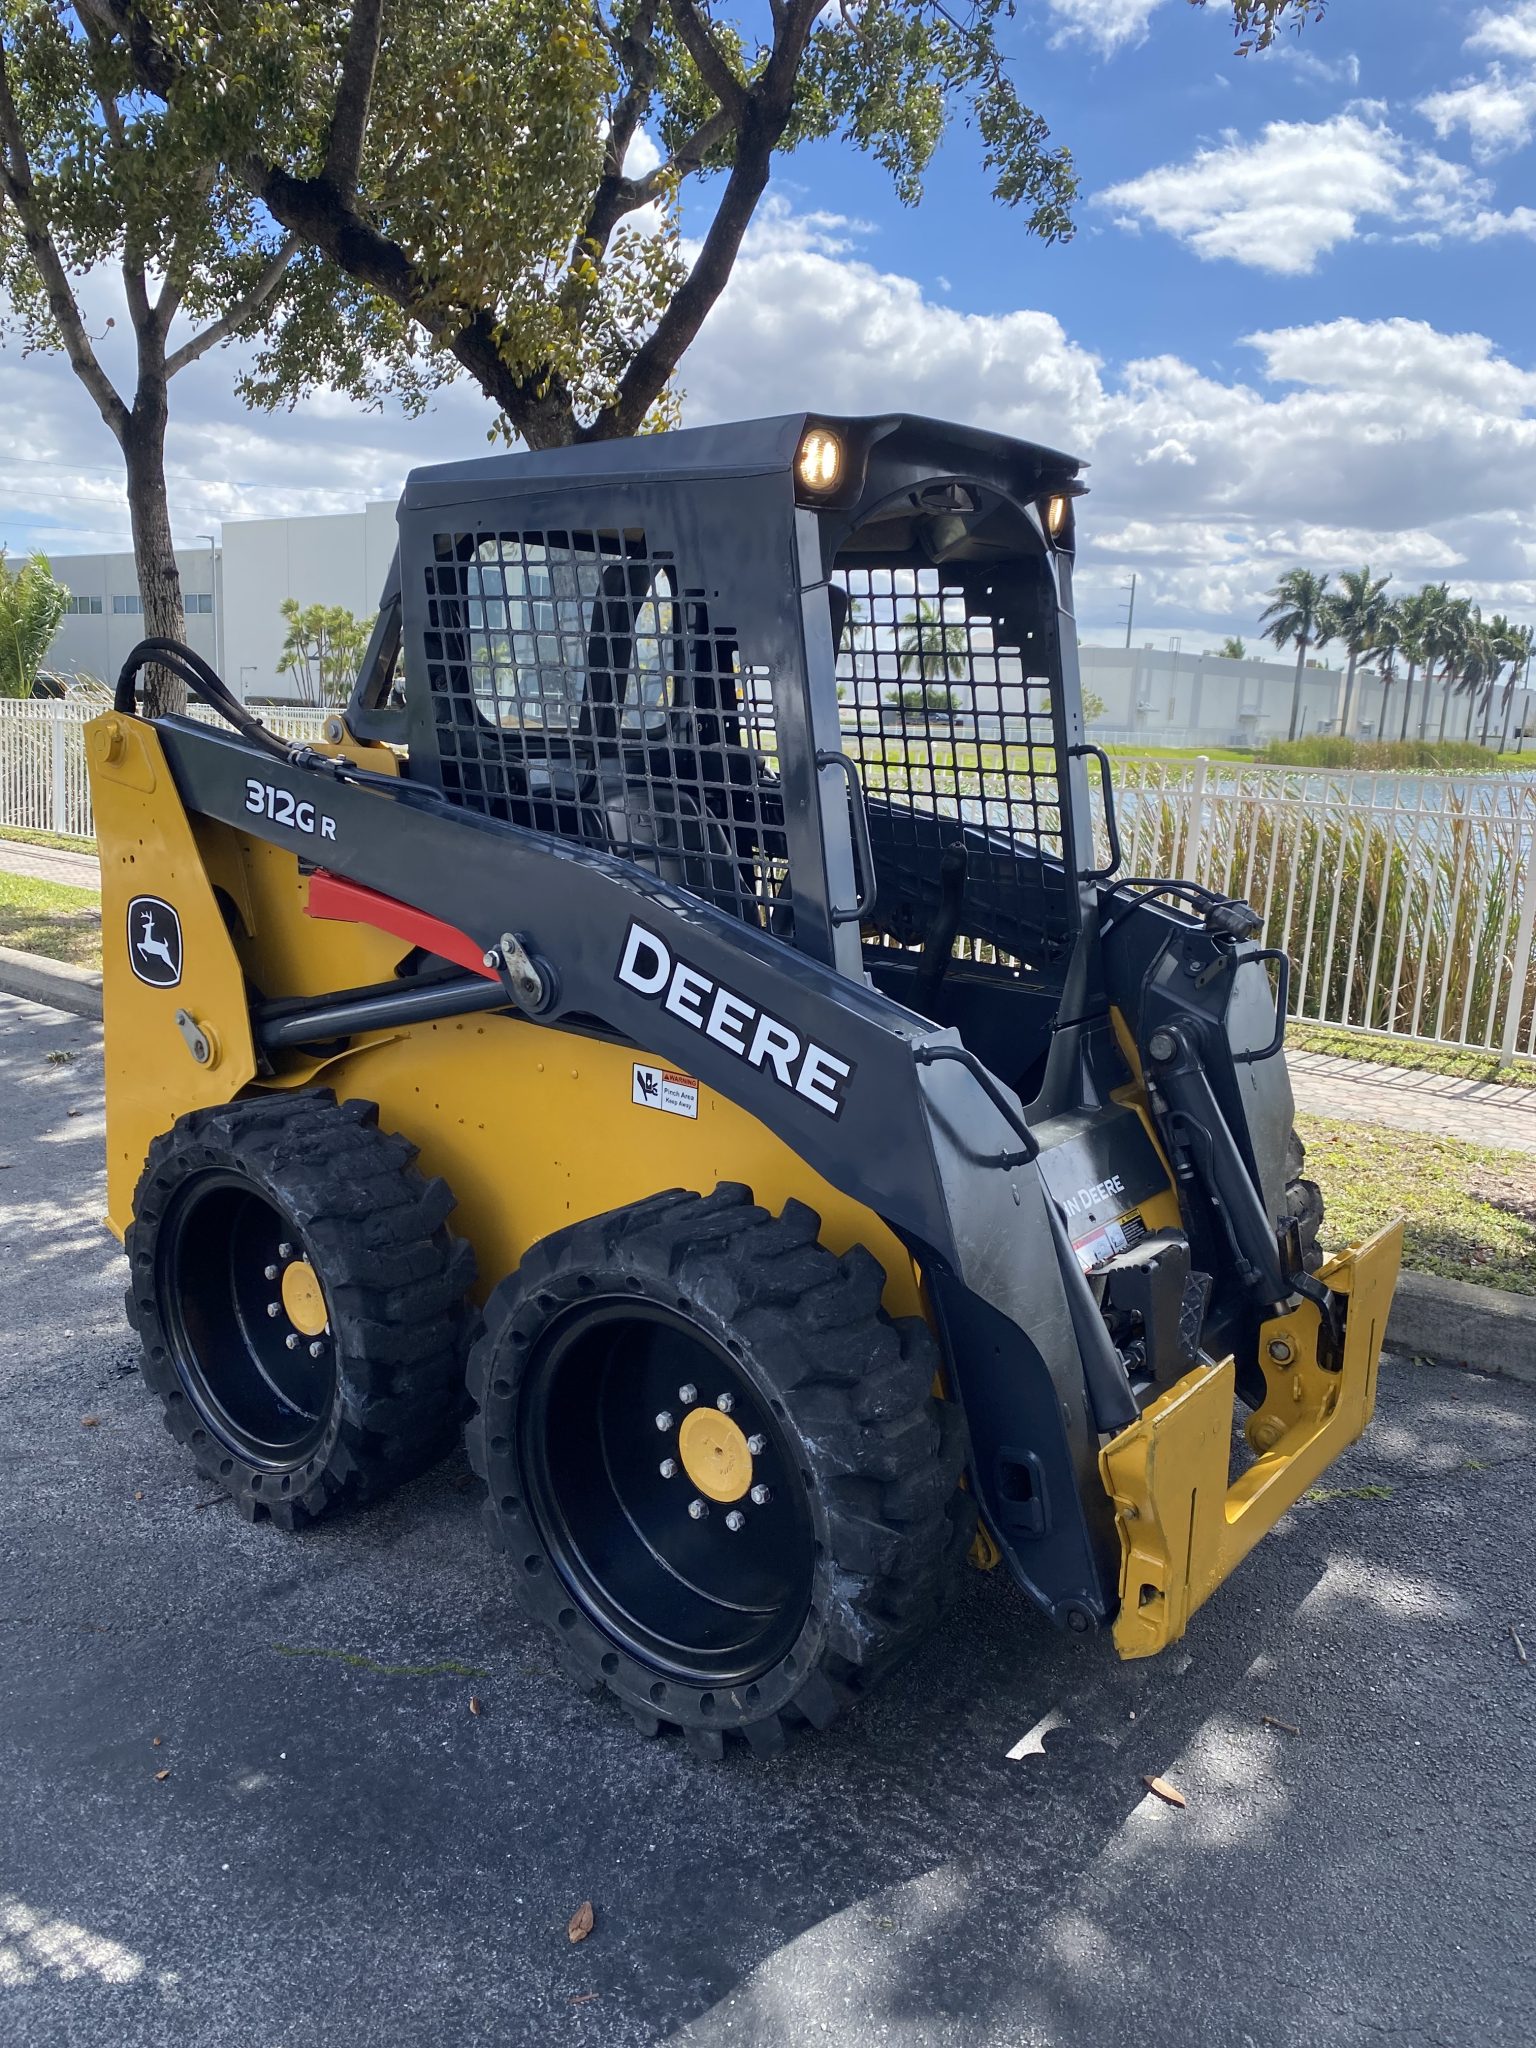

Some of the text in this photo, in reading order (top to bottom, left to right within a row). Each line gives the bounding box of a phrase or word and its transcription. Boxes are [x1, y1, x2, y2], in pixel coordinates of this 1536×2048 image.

[245, 779, 337, 841] 312G R
[618, 922, 851, 1115] DEERE
[669, 1074, 697, 1087] WARNING
[664, 1087, 695, 1102] Pinch Area
[665, 1097, 692, 1110] Keep Away
[1077, 1174, 1126, 1210] DEERE
